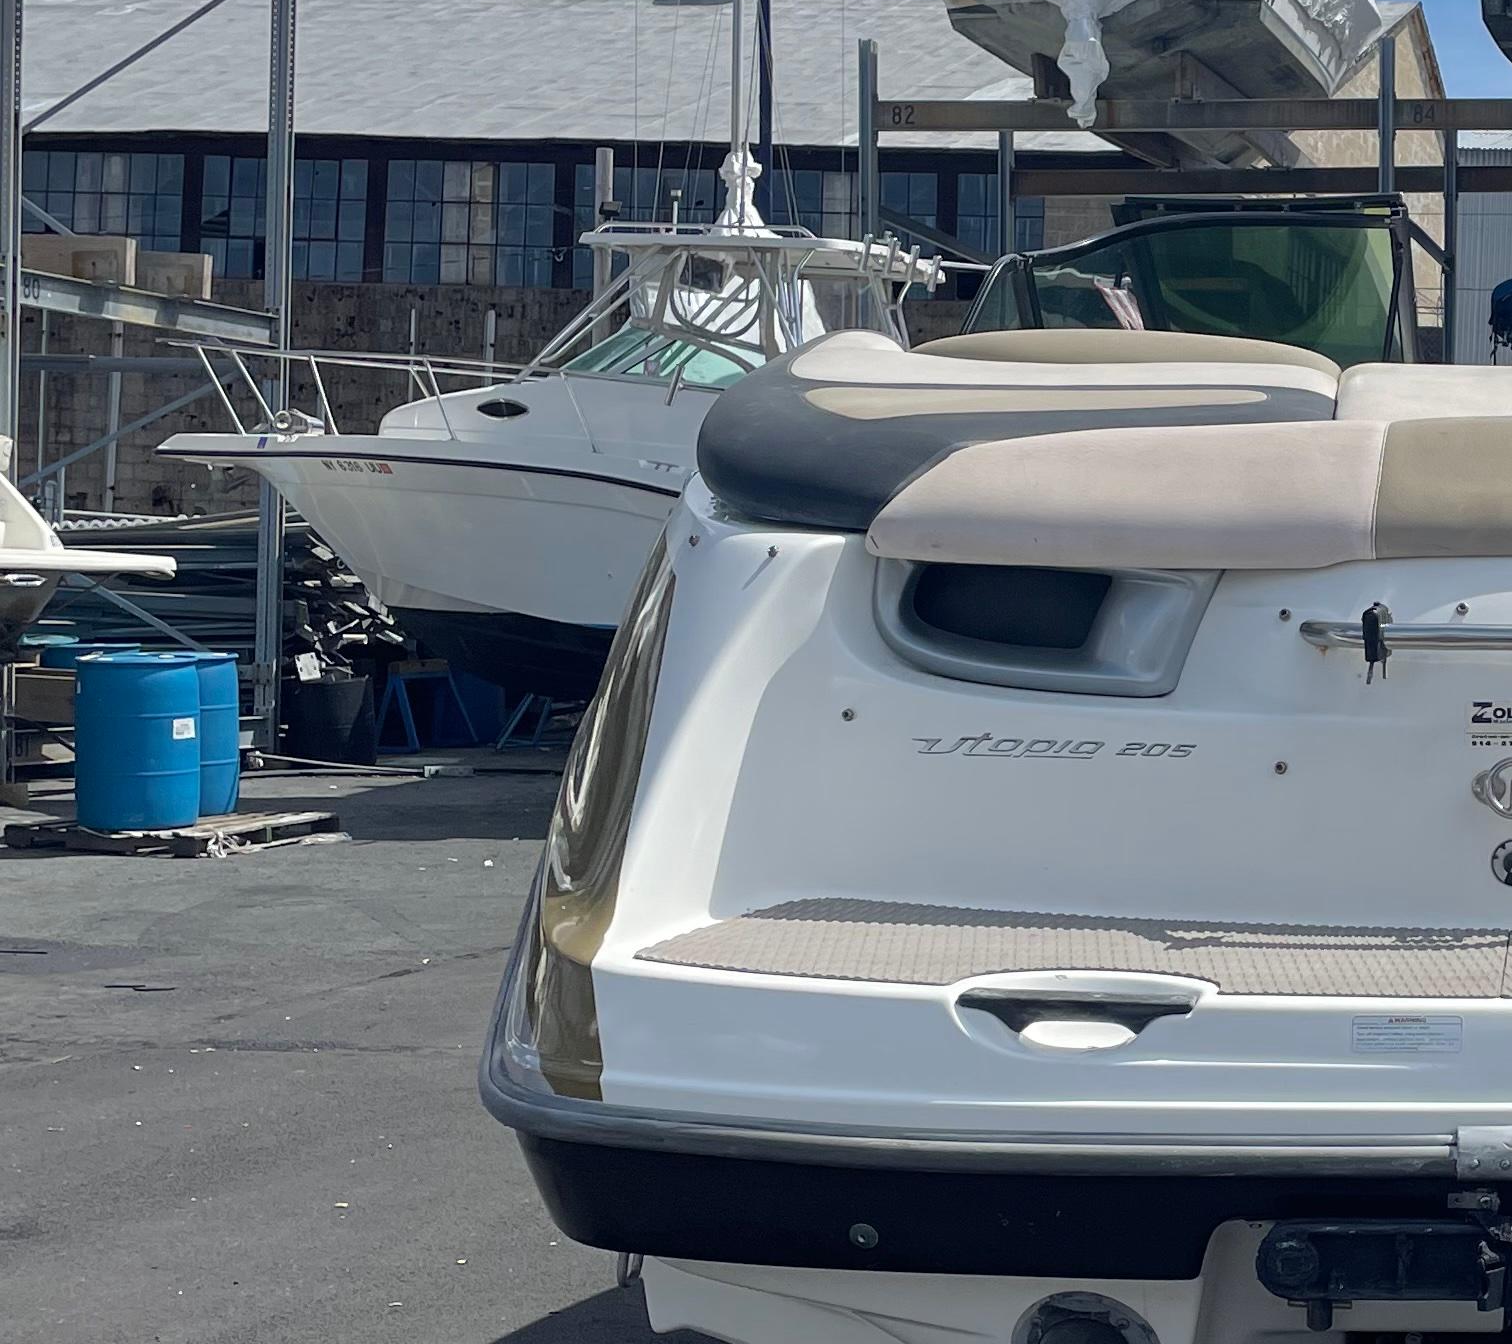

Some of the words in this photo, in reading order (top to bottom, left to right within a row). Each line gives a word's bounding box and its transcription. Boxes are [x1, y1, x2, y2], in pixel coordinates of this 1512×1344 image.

[892, 105, 915, 125] 82
[1413, 104, 1434, 123] 84
[24, 277, 40, 299] 80
[321, 460, 337, 471] NY
[1116, 742, 1197, 758] 205
